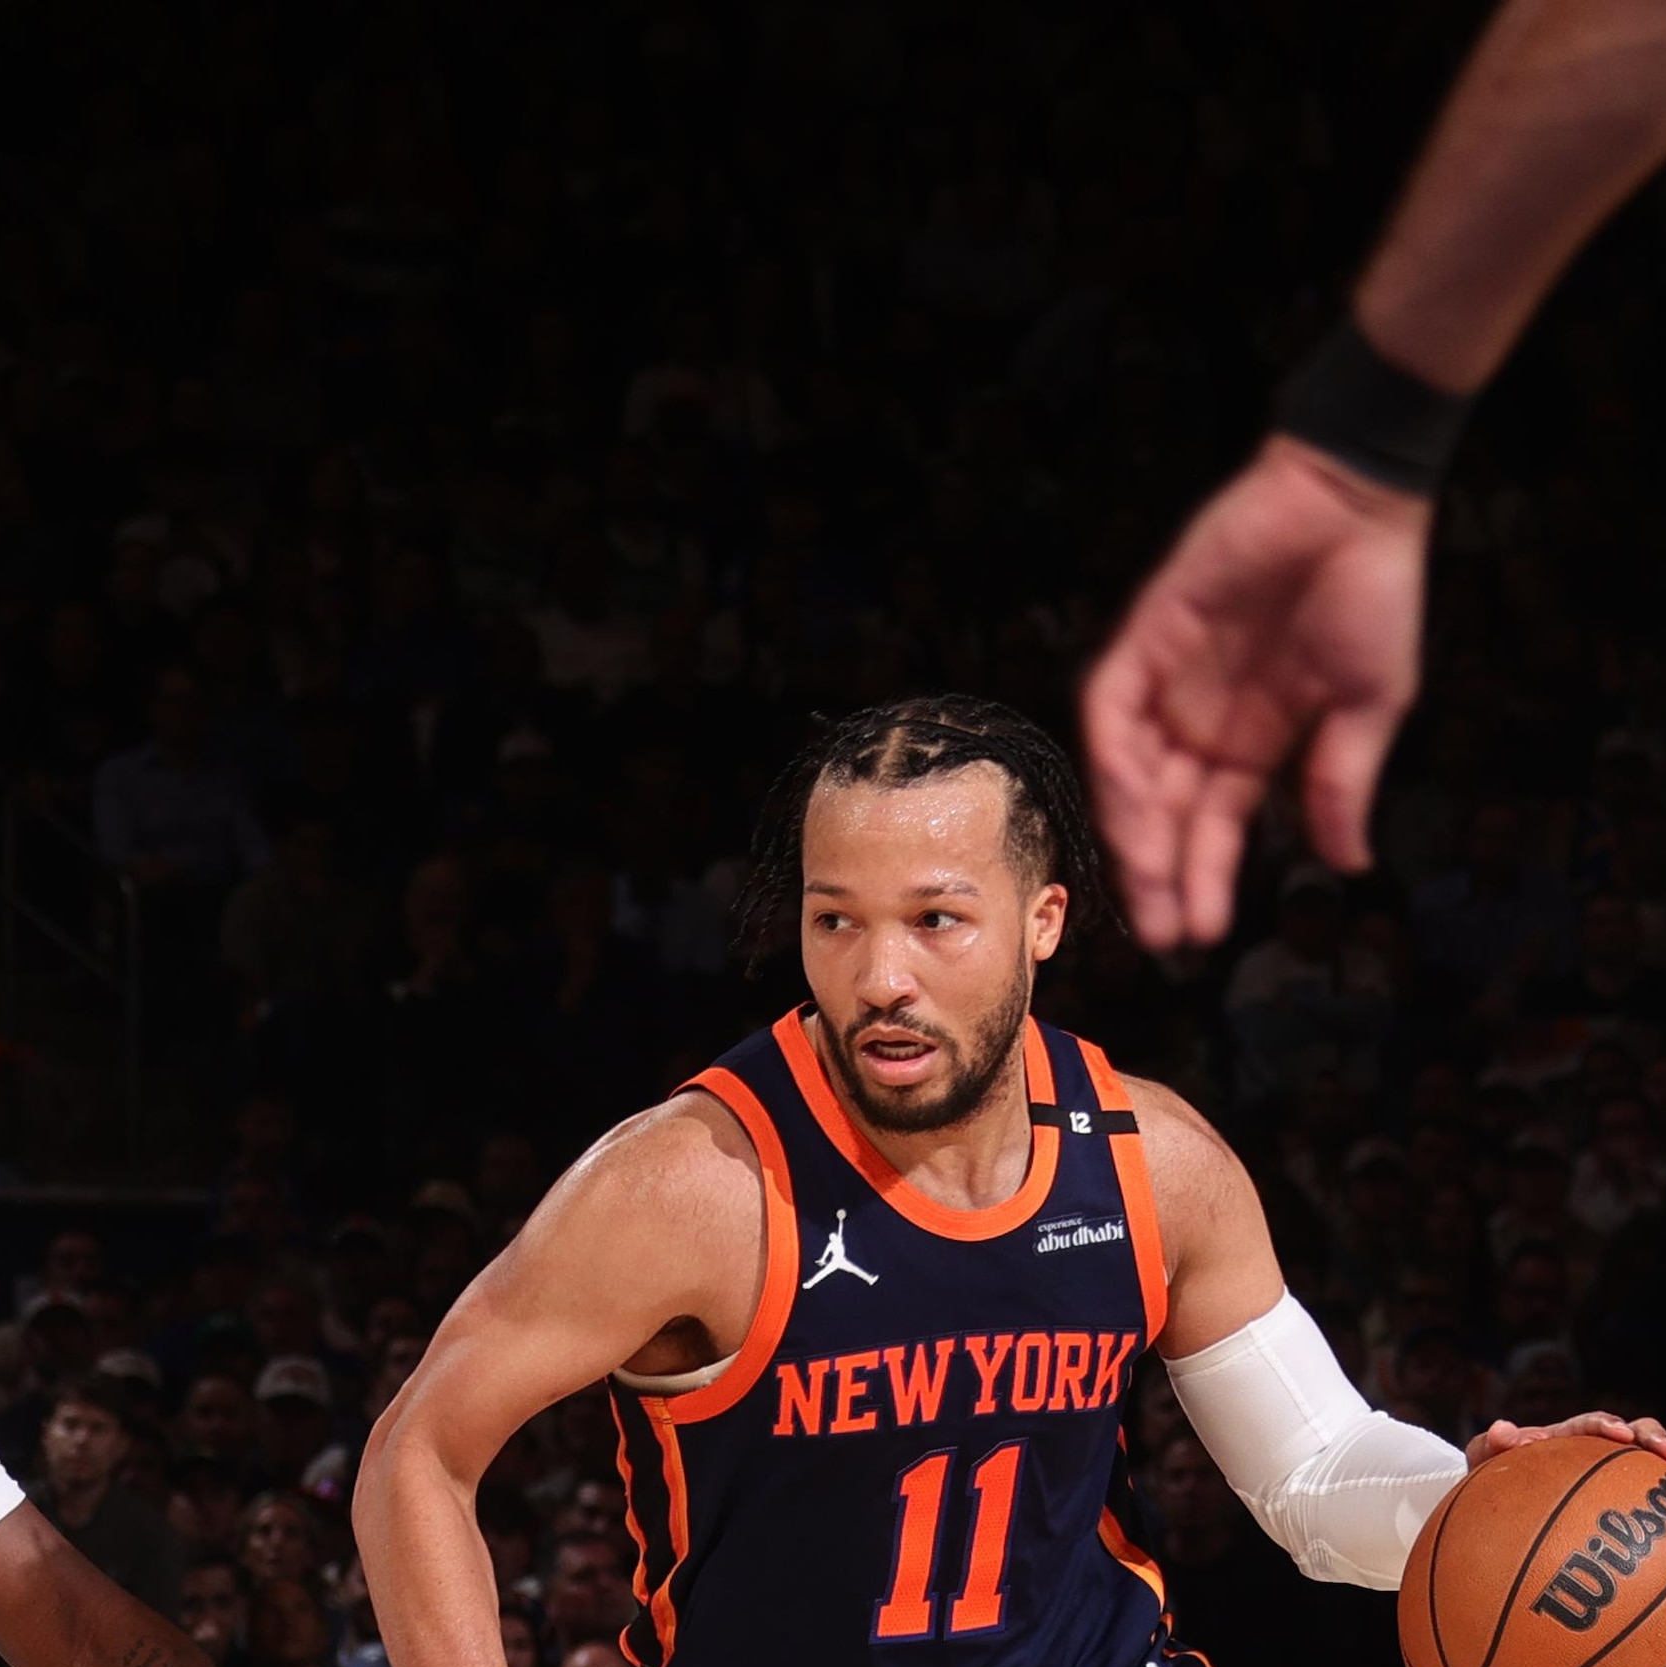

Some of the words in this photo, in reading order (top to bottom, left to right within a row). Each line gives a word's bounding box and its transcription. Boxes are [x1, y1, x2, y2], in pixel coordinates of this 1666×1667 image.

[1069, 1111, 1092, 1133] 12
[1038, 1233, 1070, 1253] abu
[1073, 1220, 1124, 1246] dhabi
[773, 1338, 955, 1436] NEW
[964, 1330, 1138, 1416] YORK
[875, 1440, 1025, 1640] 11
